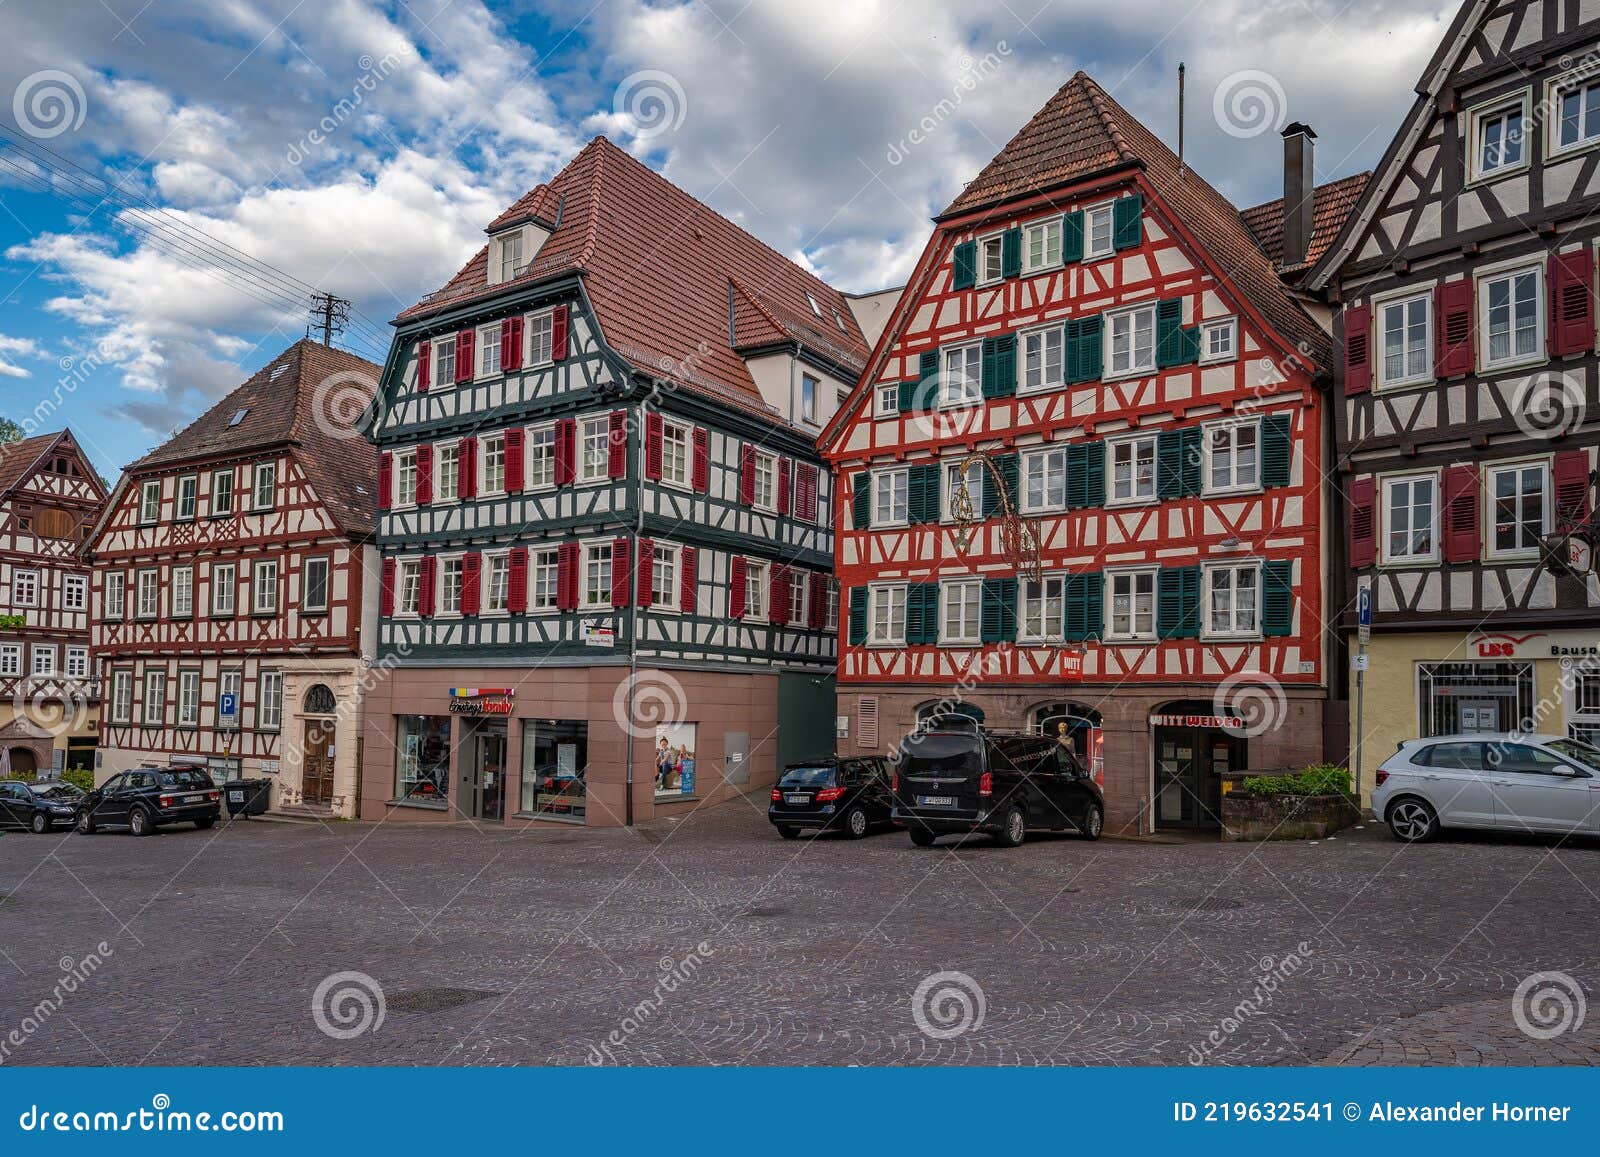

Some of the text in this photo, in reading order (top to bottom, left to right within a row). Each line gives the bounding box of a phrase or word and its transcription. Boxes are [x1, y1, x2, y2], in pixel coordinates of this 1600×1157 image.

[1362, 593, 1368, 620] P
[1478, 642, 1515, 657] LBS
[1064, 656, 1080, 670] WITT
[223, 697, 232, 712] P
[1150, 715, 1184, 727] WITT
